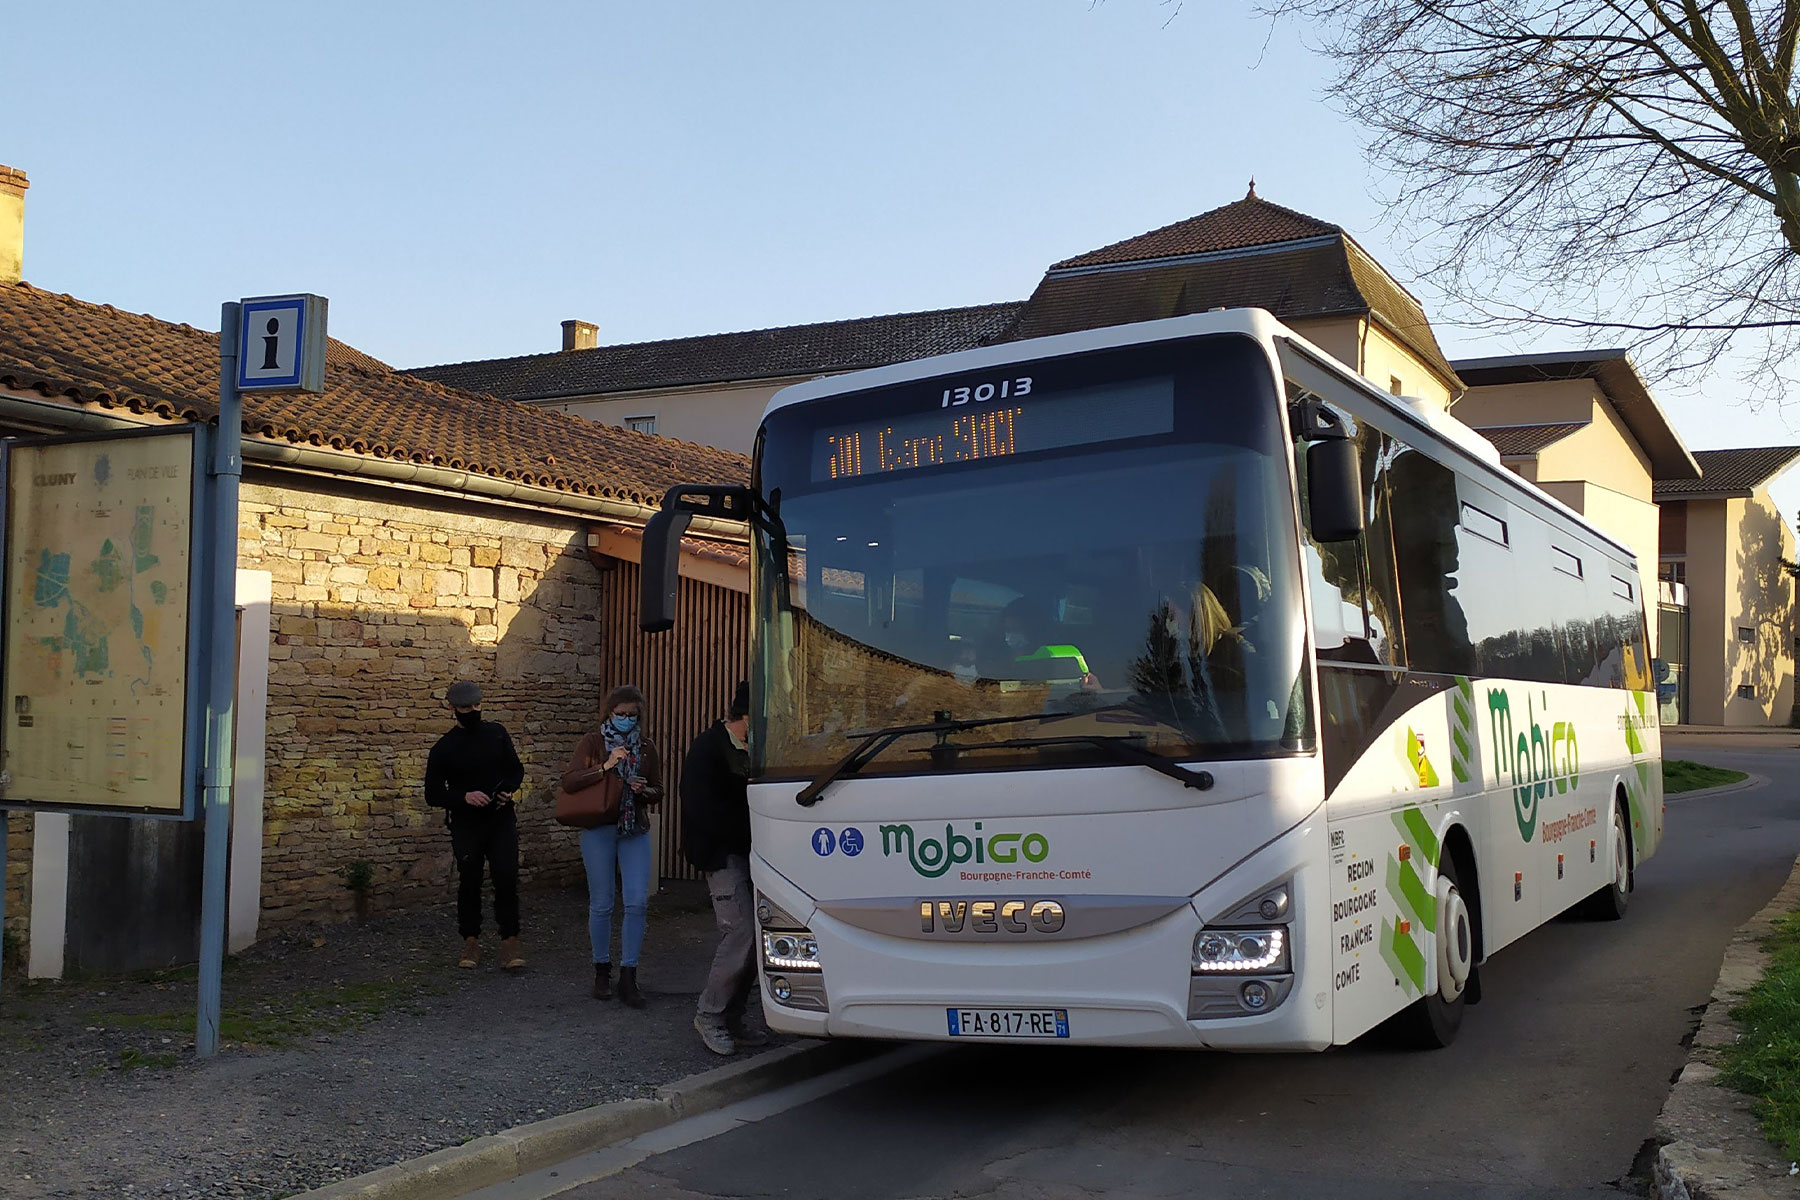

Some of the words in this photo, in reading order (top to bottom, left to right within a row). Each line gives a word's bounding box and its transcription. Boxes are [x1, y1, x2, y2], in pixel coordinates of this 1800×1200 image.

[941, 377, 1033, 408] 13013
[33, 472, 77, 487] CLUNY
[960, 868, 1092, 882] Bourgogne-Franche-Comté
[920, 900, 1066, 933] IVECO
[1333, 889, 1377, 922] BOURGOGNE
[1340, 924, 1372, 954] FRANCHE
[961, 1012, 1055, 1034] FA-817-RE
[1056, 1024, 1066, 1034] 71
